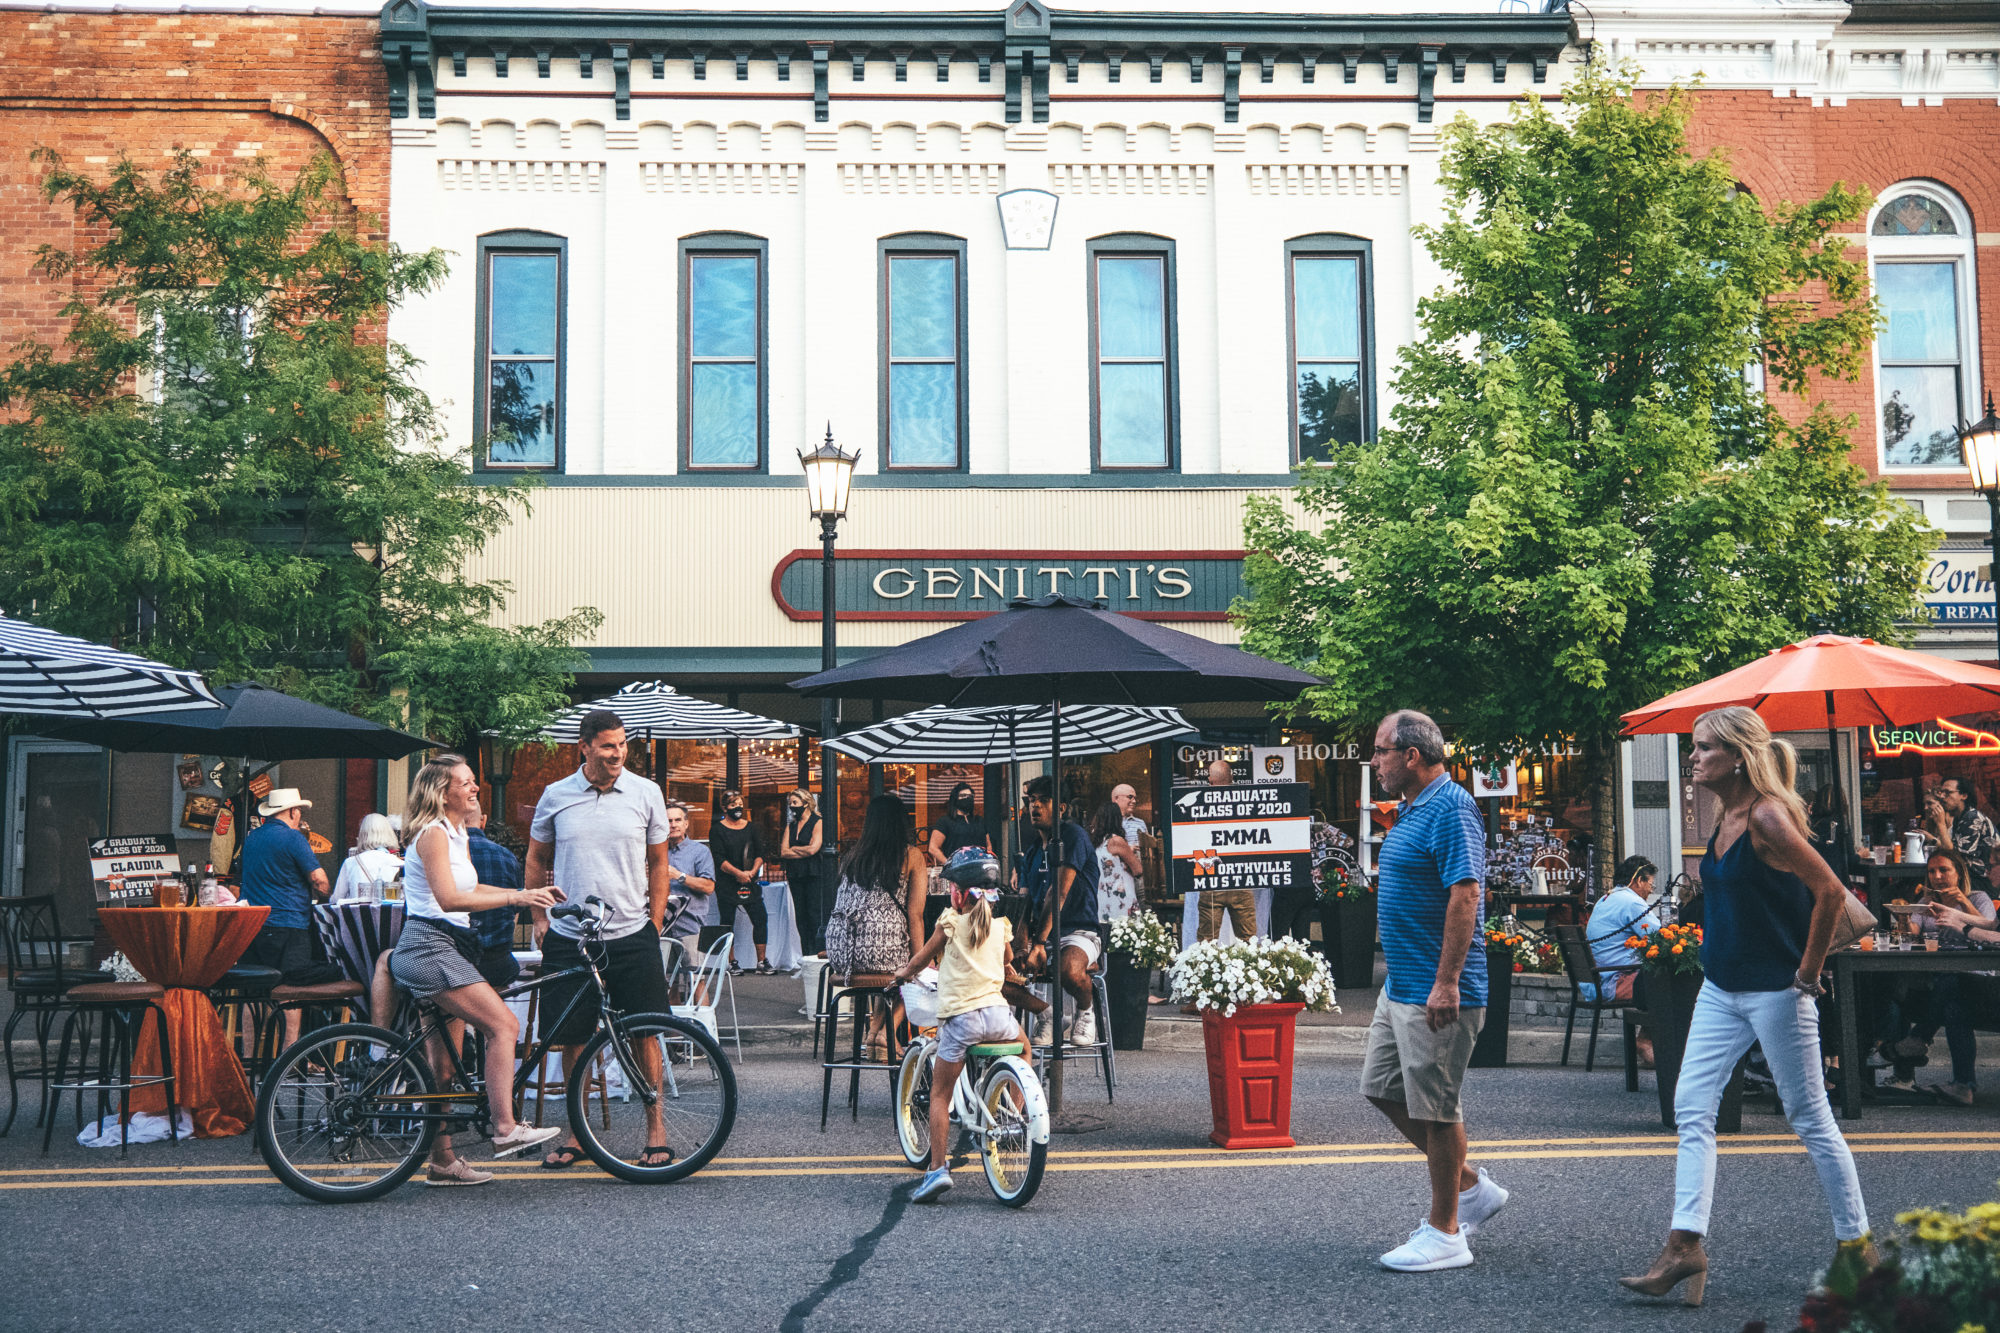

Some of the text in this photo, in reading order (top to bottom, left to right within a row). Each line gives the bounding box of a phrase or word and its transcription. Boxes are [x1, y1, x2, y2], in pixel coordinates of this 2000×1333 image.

[872, 565, 1193, 600] GENITTI'S
[1945, 605, 1997, 619] REPAI
[1878, 730, 1961, 745] SERVICE
[1297, 743, 1360, 760] HOLE
[1203, 789, 1278, 803] GRADUATE
[1190, 802, 1291, 818] CLASS OF 2020
[109, 837, 157, 847] GRADUATE
[1211, 828, 1271, 846] EMMA
[102, 846, 130, 856] CLASS
[145, 845, 166, 853] 2020
[110, 860, 164, 873] CLAUDIA
[1193, 873, 1292, 890] MUSTANGS
